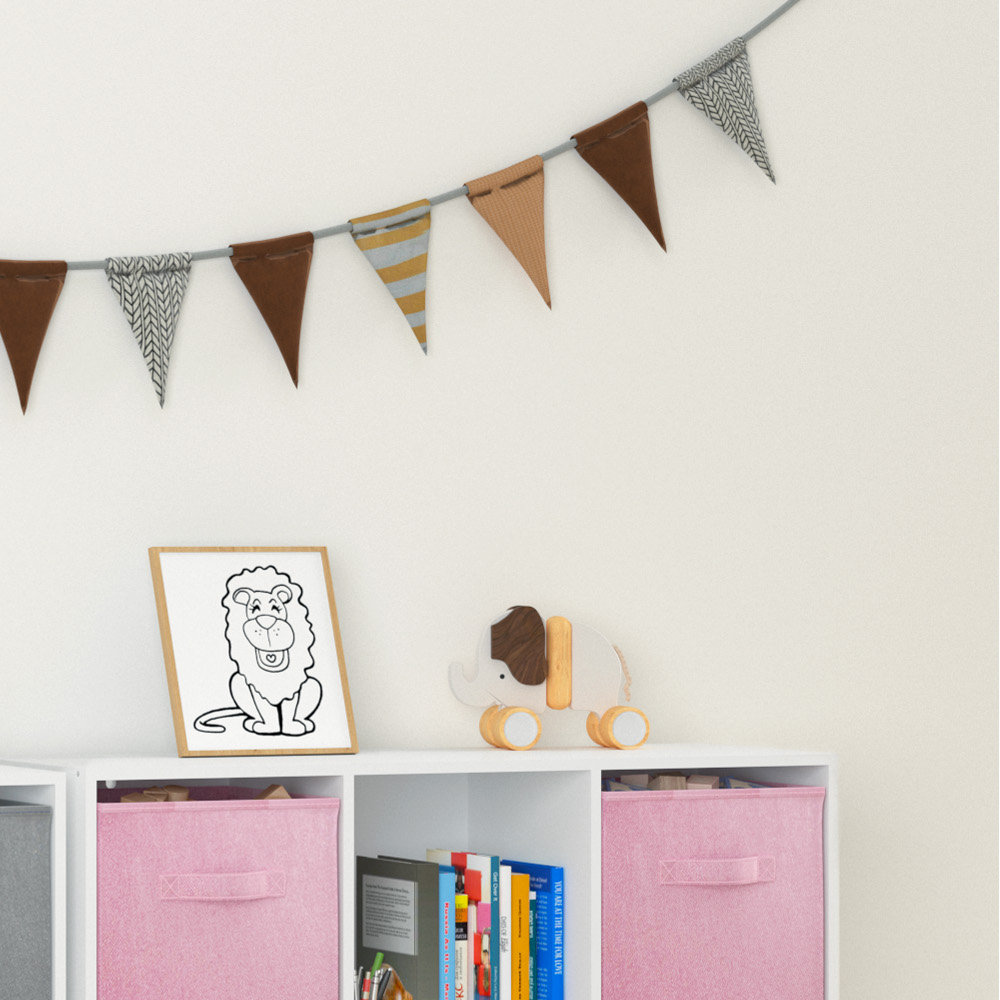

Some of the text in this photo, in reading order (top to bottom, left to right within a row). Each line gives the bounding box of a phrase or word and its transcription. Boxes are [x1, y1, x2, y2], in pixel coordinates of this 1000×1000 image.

[554, 880, 562, 895] YOU
[554, 895, 562, 907] ARE
[554, 916, 562, 929] THE
[554, 930, 562, 945] TIME
[554, 946, 562, 959] FOR
[554, 959, 562, 975] LOVE
